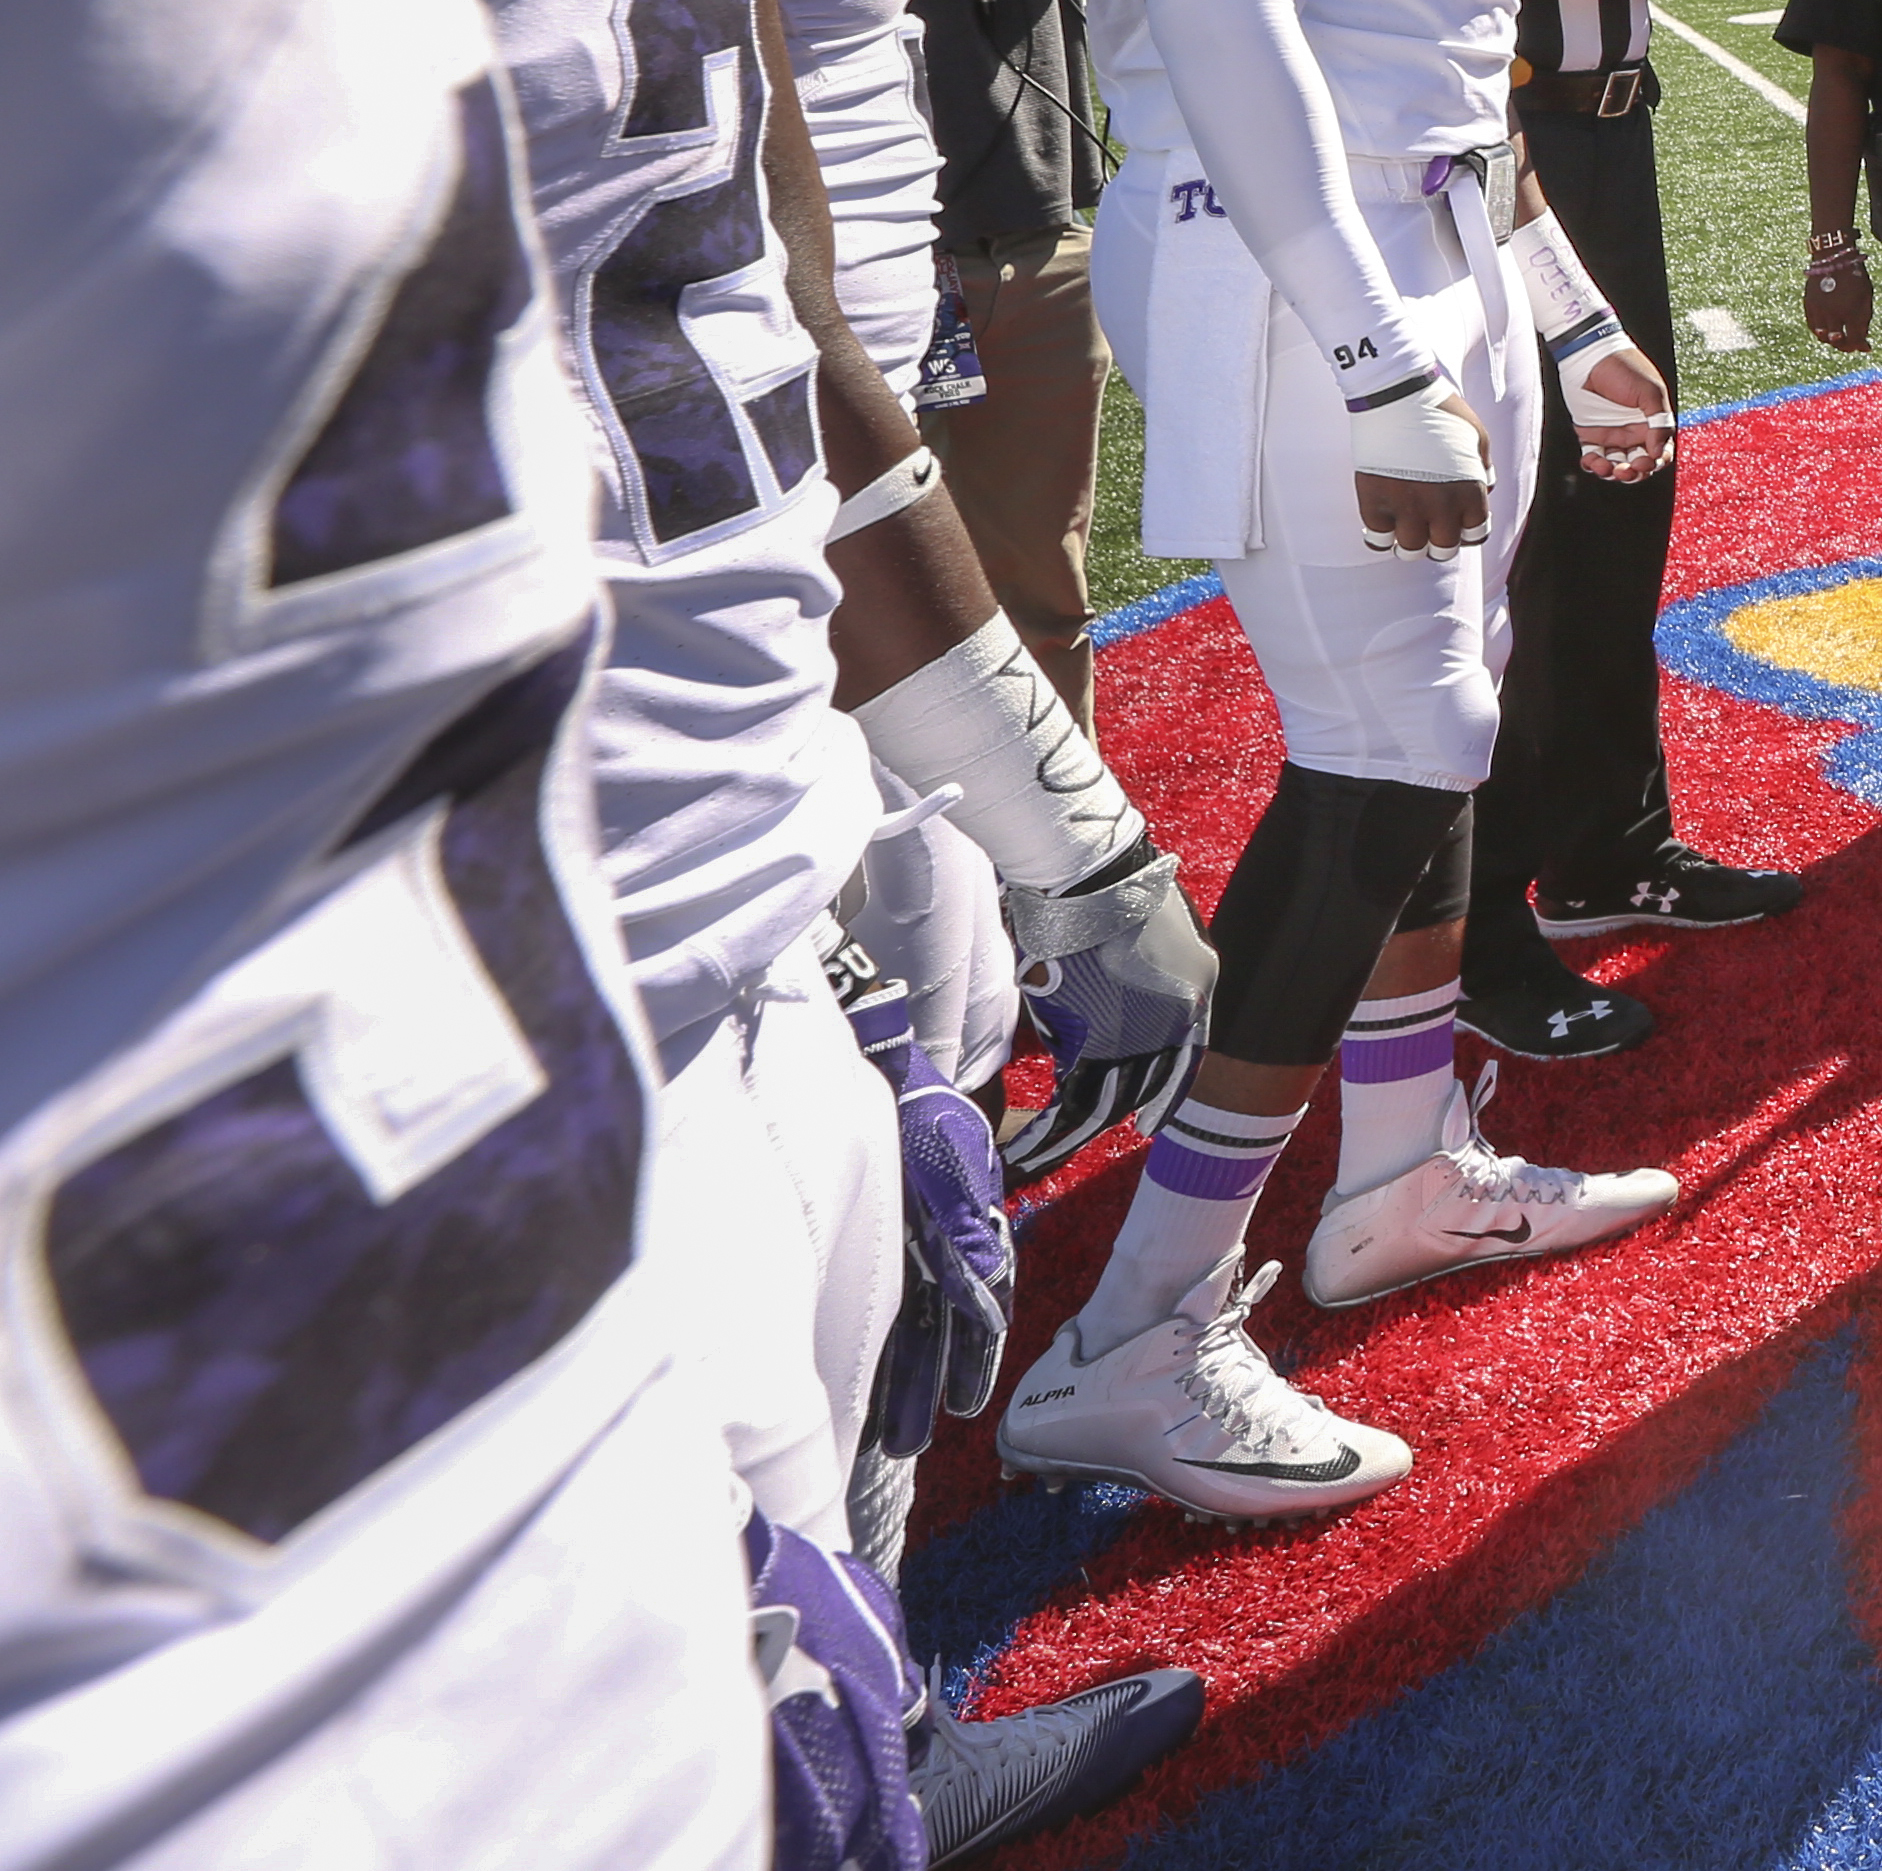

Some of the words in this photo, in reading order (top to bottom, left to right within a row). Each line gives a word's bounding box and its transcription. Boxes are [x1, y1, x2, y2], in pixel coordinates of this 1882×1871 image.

[927, 358, 960, 376] WS
[1333, 335, 1379, 371] 94
[824, 941, 881, 1001] CU
[1018, 1384, 1076, 1410] ALPHA
